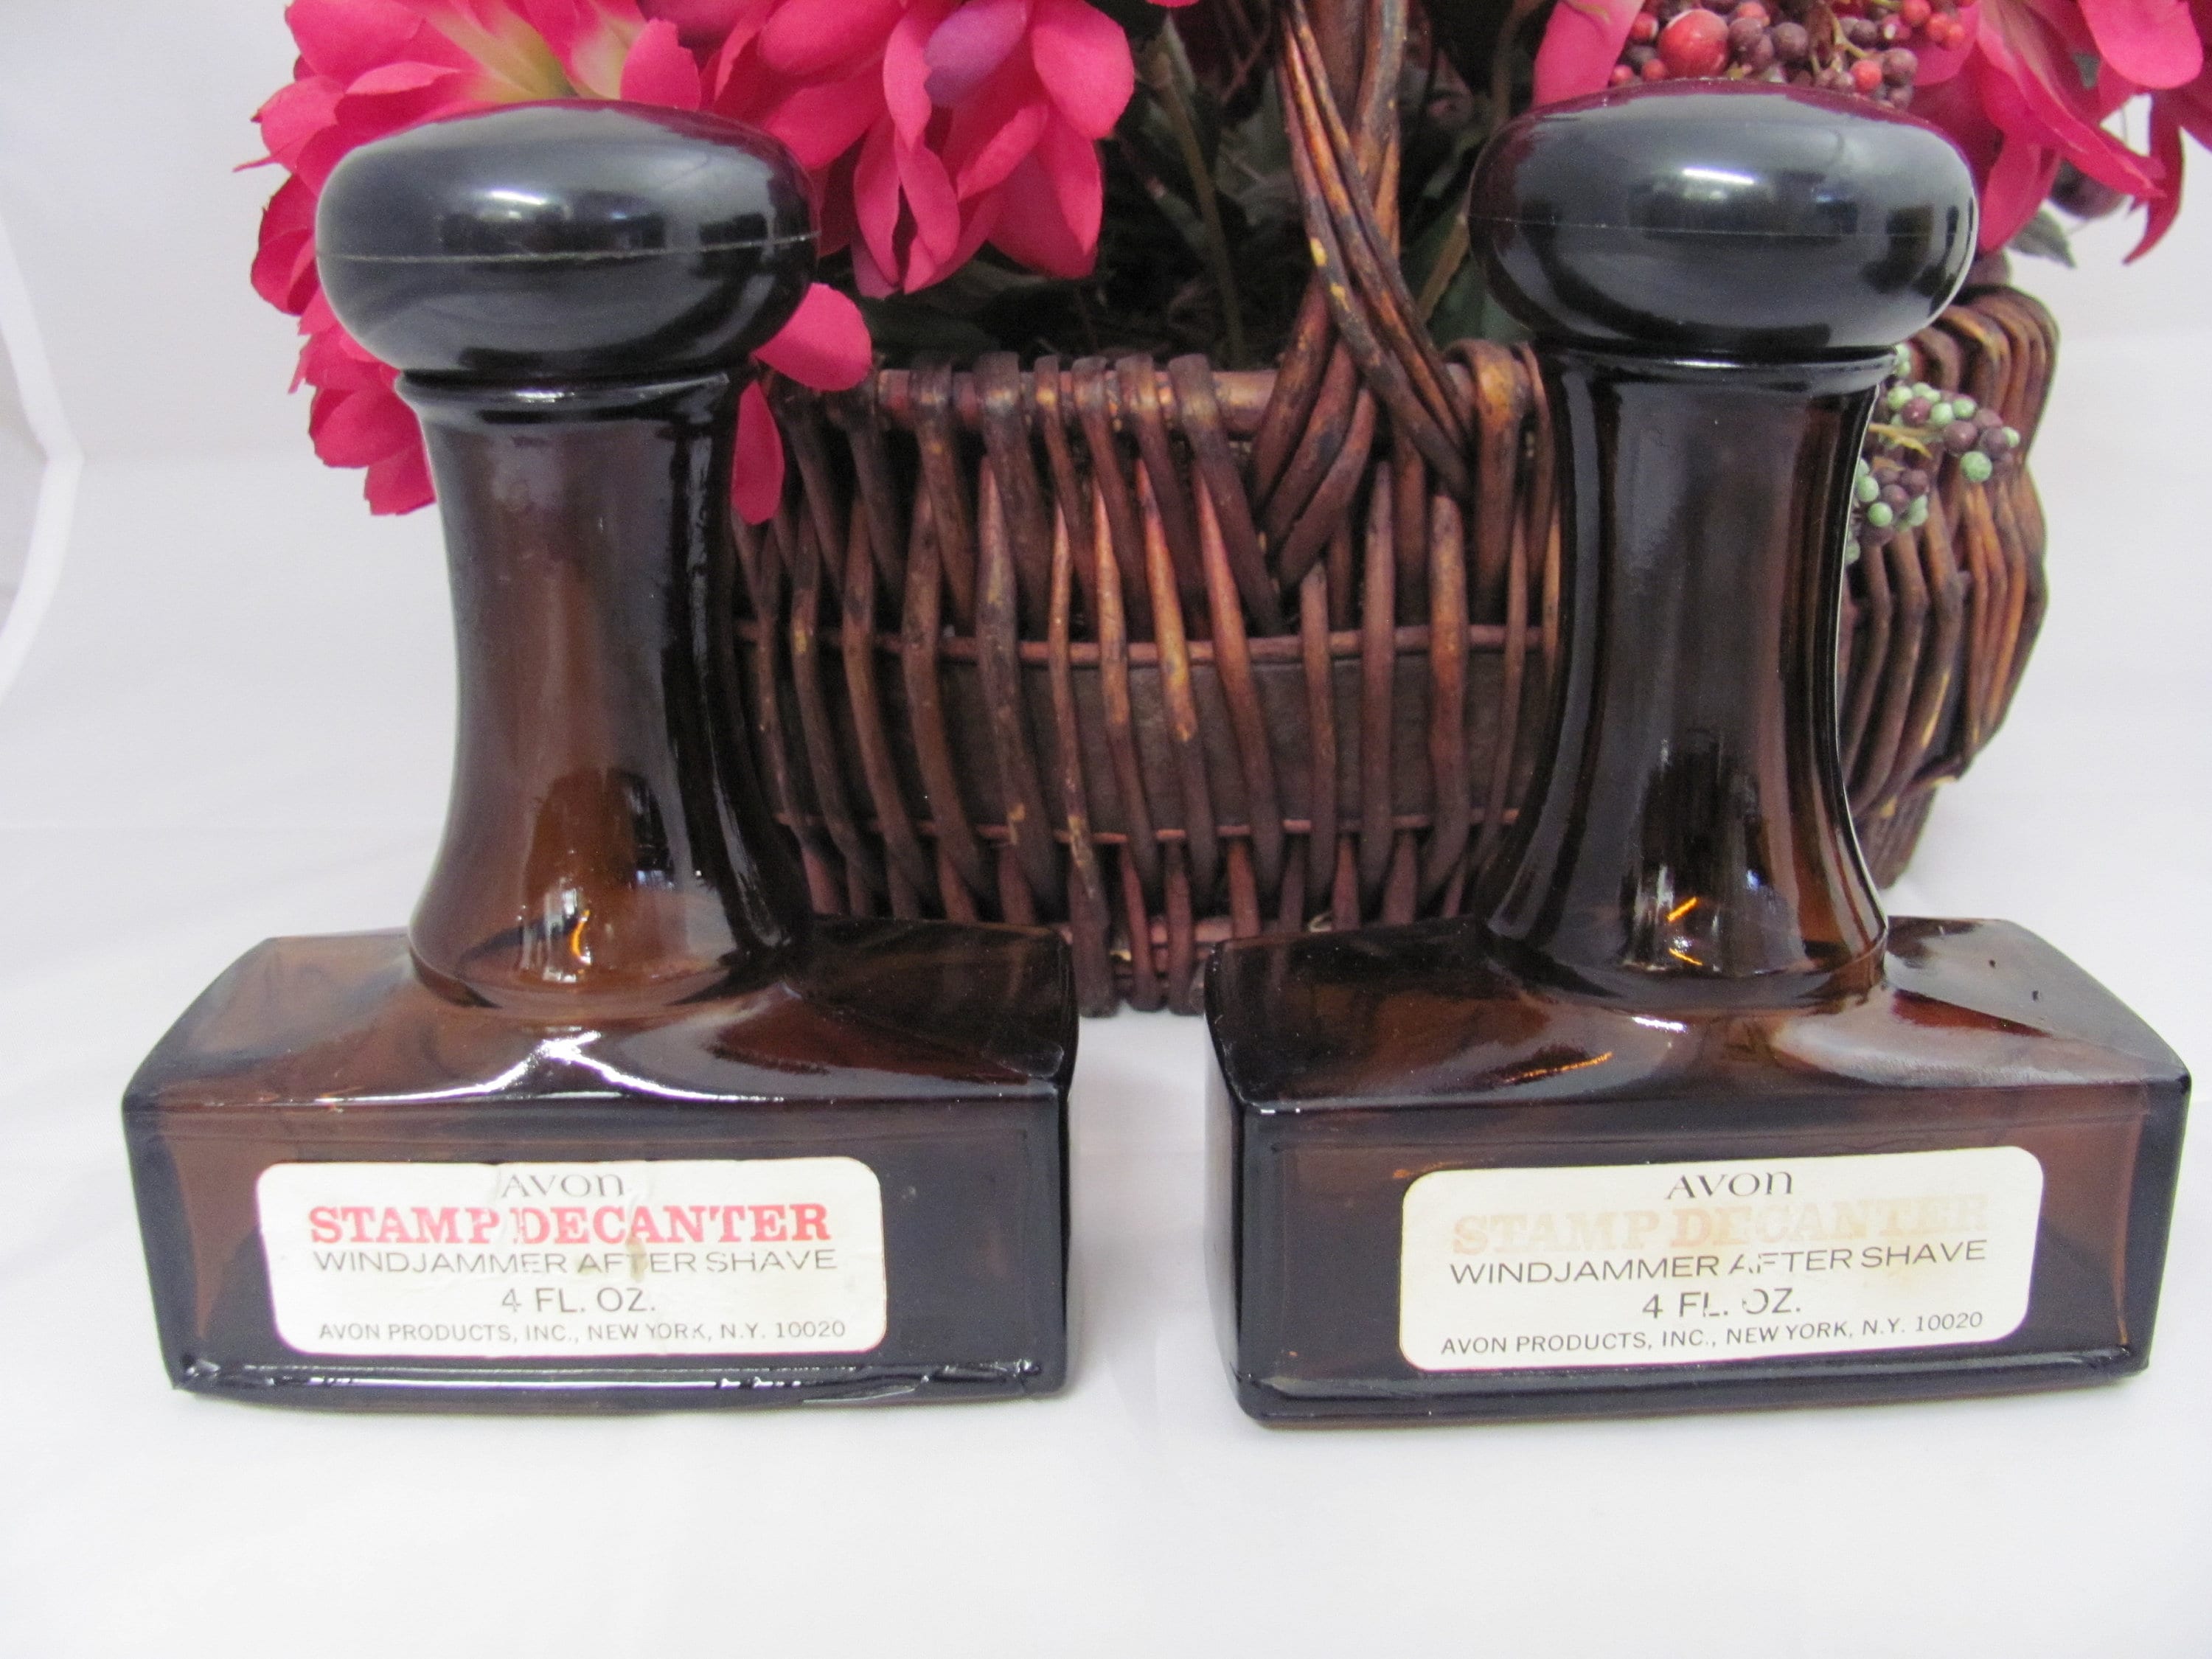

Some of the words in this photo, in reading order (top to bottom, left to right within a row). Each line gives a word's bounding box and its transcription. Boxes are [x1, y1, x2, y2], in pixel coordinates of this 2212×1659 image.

[308, 1206, 501, 1245] STAMP
[510, 1203, 831, 1245] DECANTER
[1453, 1211, 1660, 1256] STAMP
[1669, 1194, 1989, 1248] DECANTER
[313, 1251, 568, 1273] WINDJAMMER
[577, 1251, 698, 1274] AFTER
[706, 1249, 838, 1273] SHAVE
[1450, 1256, 1719, 1284] WINDJAMMER
[1728, 1248, 1851, 1275] AFTER
[1861, 1239, 1987, 1267] SHAVE
[501, 1288, 521, 1312] 4
[535, 1287, 585, 1313] FL.
[597, 1287, 655, 1312] OZ.
[1643, 1293, 1663, 1319] 4
[1679, 1292, 1728, 1318] FL.
[1742, 1288, 1801, 1315] OZ.
[319, 1323, 380, 1340] AVON
[389, 1324, 518, 1343] PRODUCTS,
[588, 1324, 639, 1340] NEW
[647, 1323, 713, 1342] YORK,
[721, 1322, 765, 1340] N.Y.
[776, 1321, 846, 1338] 10020
[1441, 1337, 1507, 1355] AVON
[1517, 1332, 1652, 1352] PRODUCTS,
[1662, 1329, 1717, 1349] INC.,
[1726, 1326, 1778, 1344] NEW
[1786, 1321, 1853, 1341] YORK,
[1863, 1318, 1906, 1336] N.Y.
[1917, 1311, 1983, 1332] 10020
